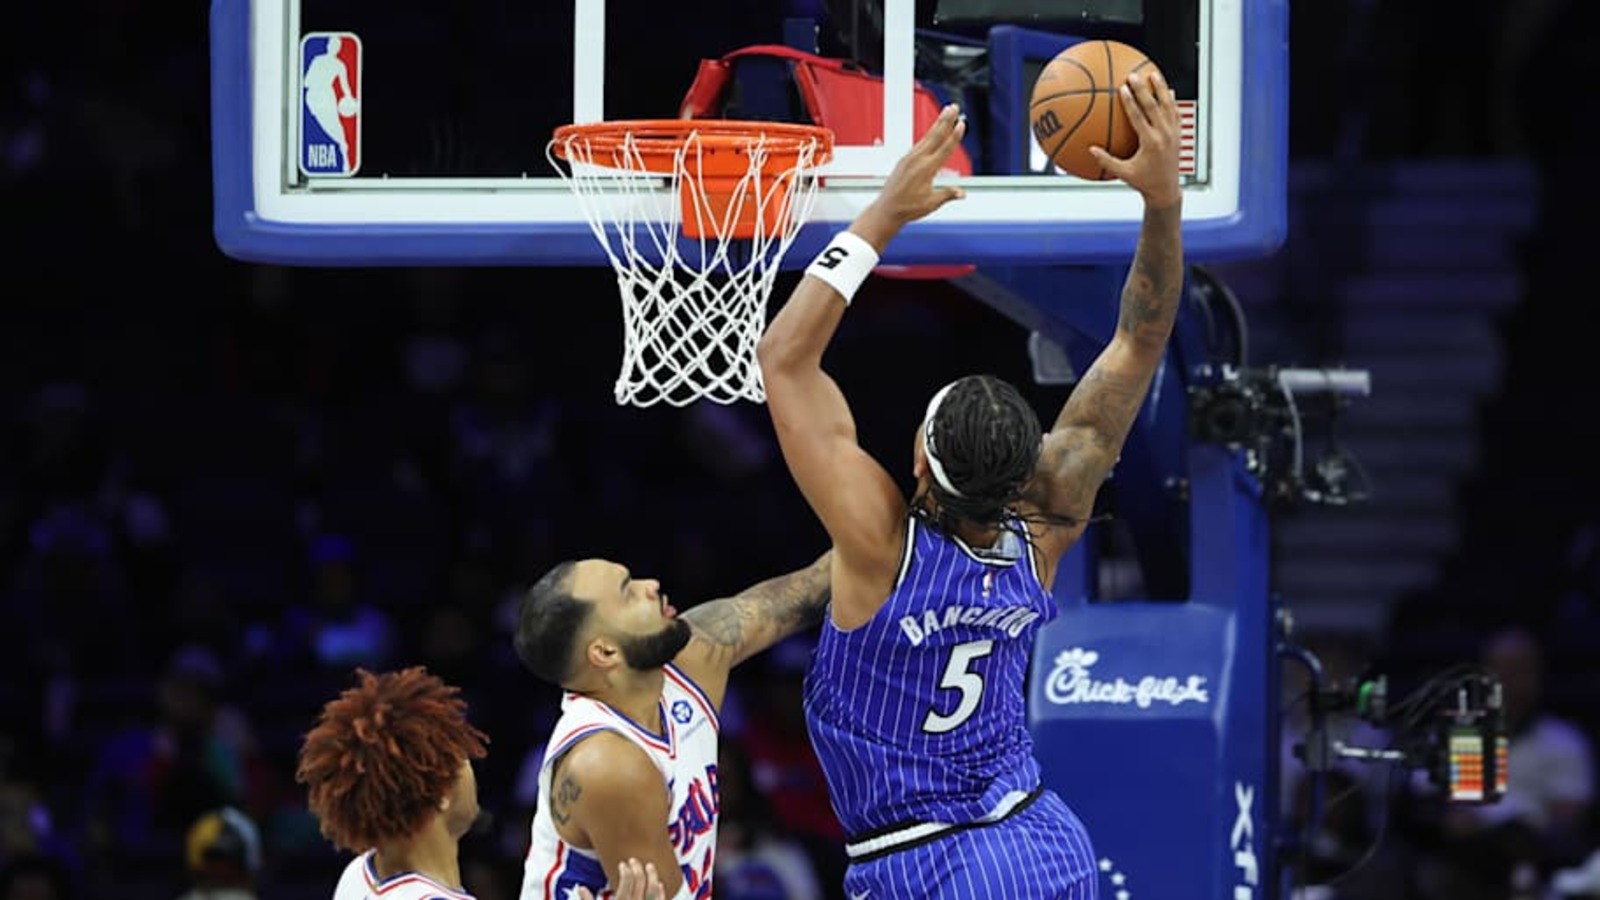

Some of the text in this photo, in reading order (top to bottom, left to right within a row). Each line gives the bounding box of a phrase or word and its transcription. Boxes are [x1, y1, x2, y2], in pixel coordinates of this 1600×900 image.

[308, 144, 338, 168] NBA
[817, 246, 849, 270] 5
[900, 604, 1040, 646] BANCHERO
[923, 639, 995, 733] 5
